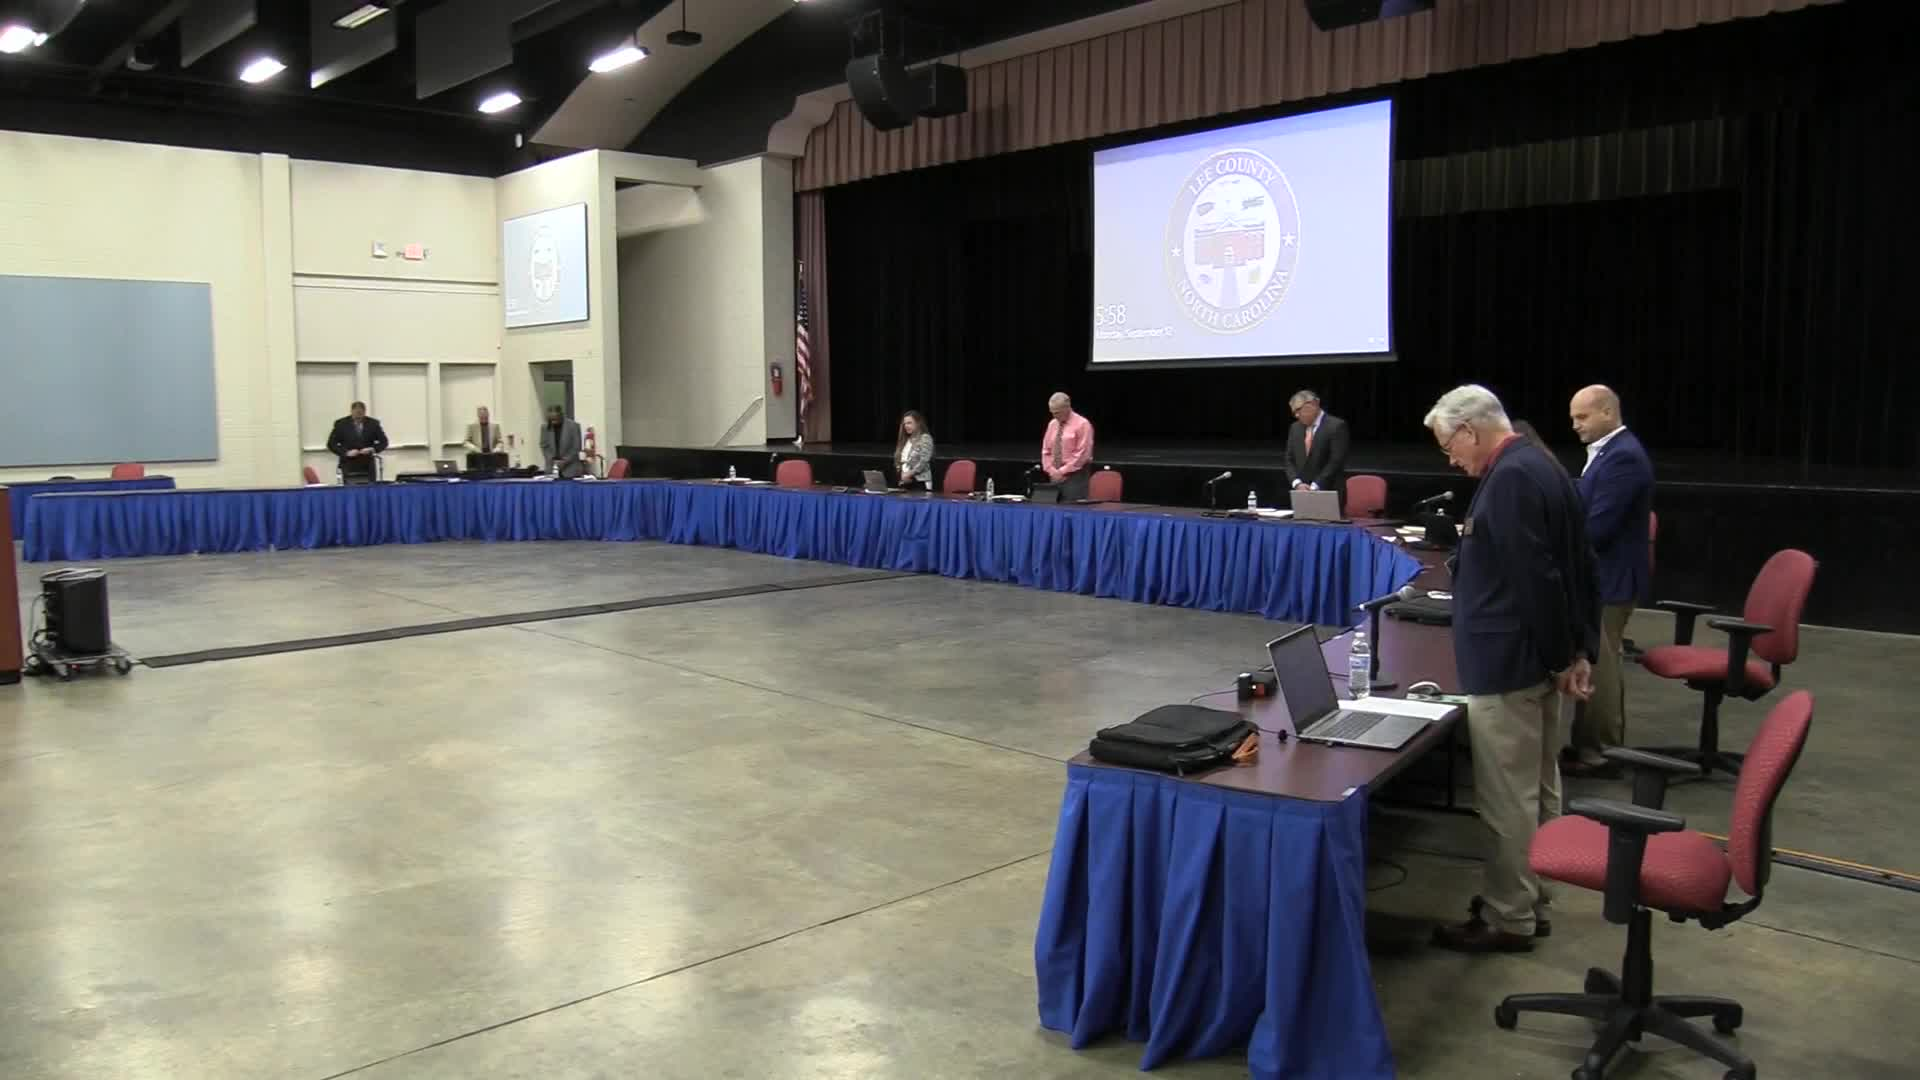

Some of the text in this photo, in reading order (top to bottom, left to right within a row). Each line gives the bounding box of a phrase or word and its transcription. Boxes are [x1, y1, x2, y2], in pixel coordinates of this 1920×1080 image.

[1190, 157, 1277, 195] LEE COUNTY
[1177, 270, 1289, 328] NORTH CAROLINA
